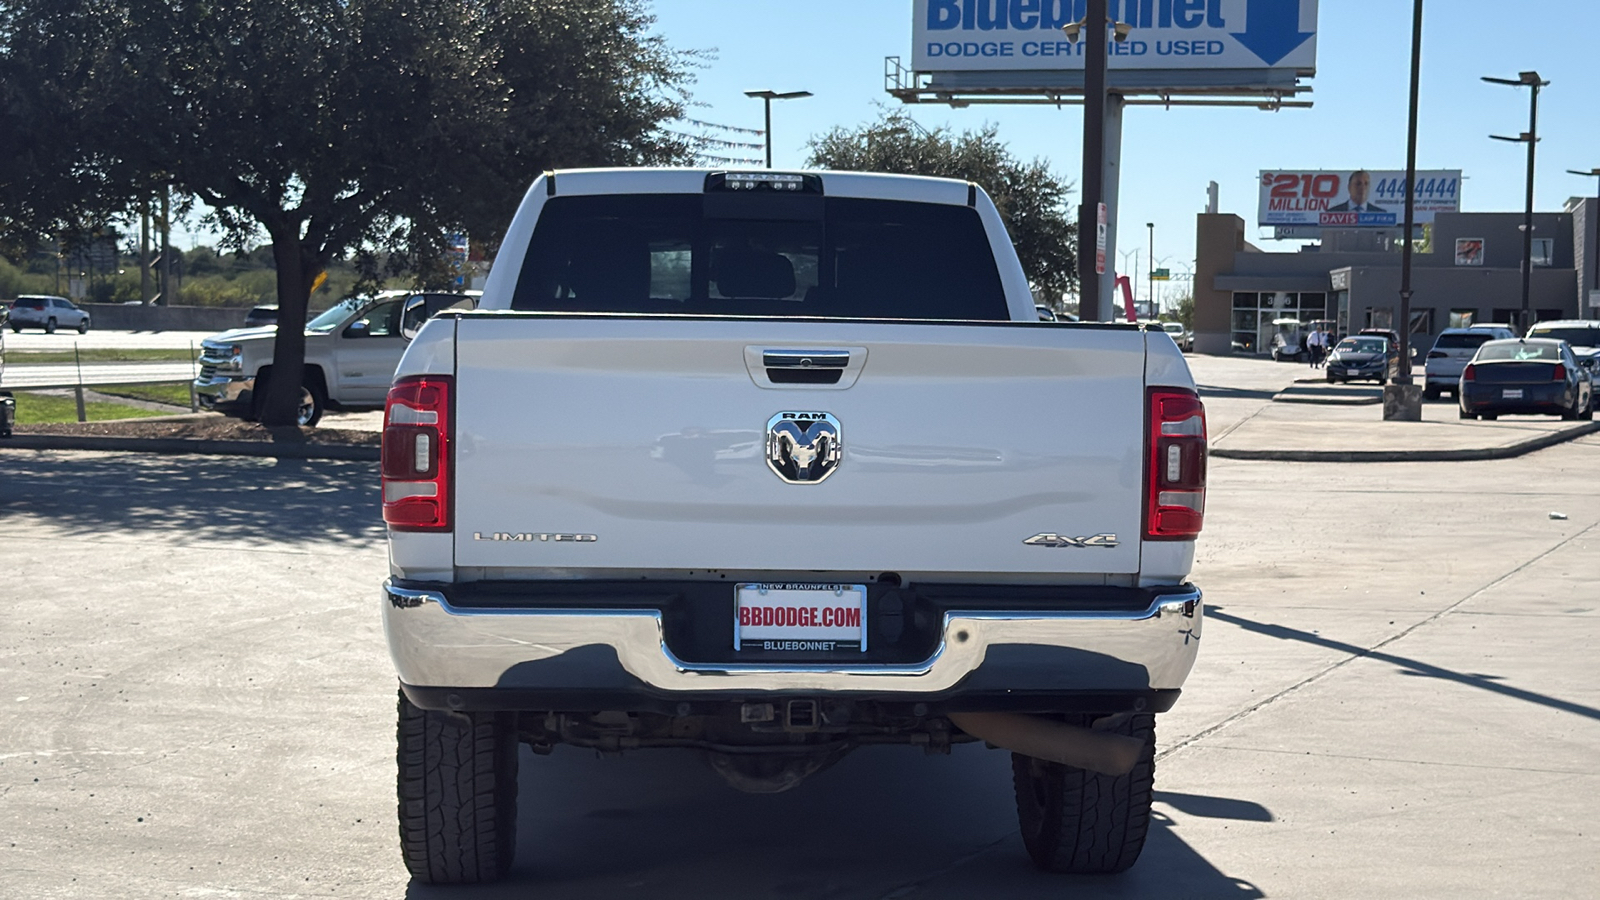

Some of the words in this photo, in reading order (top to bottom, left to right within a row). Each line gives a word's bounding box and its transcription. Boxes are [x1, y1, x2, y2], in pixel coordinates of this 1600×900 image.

[927, 41, 1014, 57] DODGE
[1021, 41, 1148, 56] CERTIED
[1156, 40, 1225, 56] USED
[1262, 173, 1340, 199] $210
[1268, 198, 1330, 211] MILLION
[1321, 213, 1356, 225] DAVIS
[473, 532, 598, 542] LIMITED
[740, 606, 860, 627] BBDODGE.COM
[764, 641, 836, 651] BLUEBONNET
